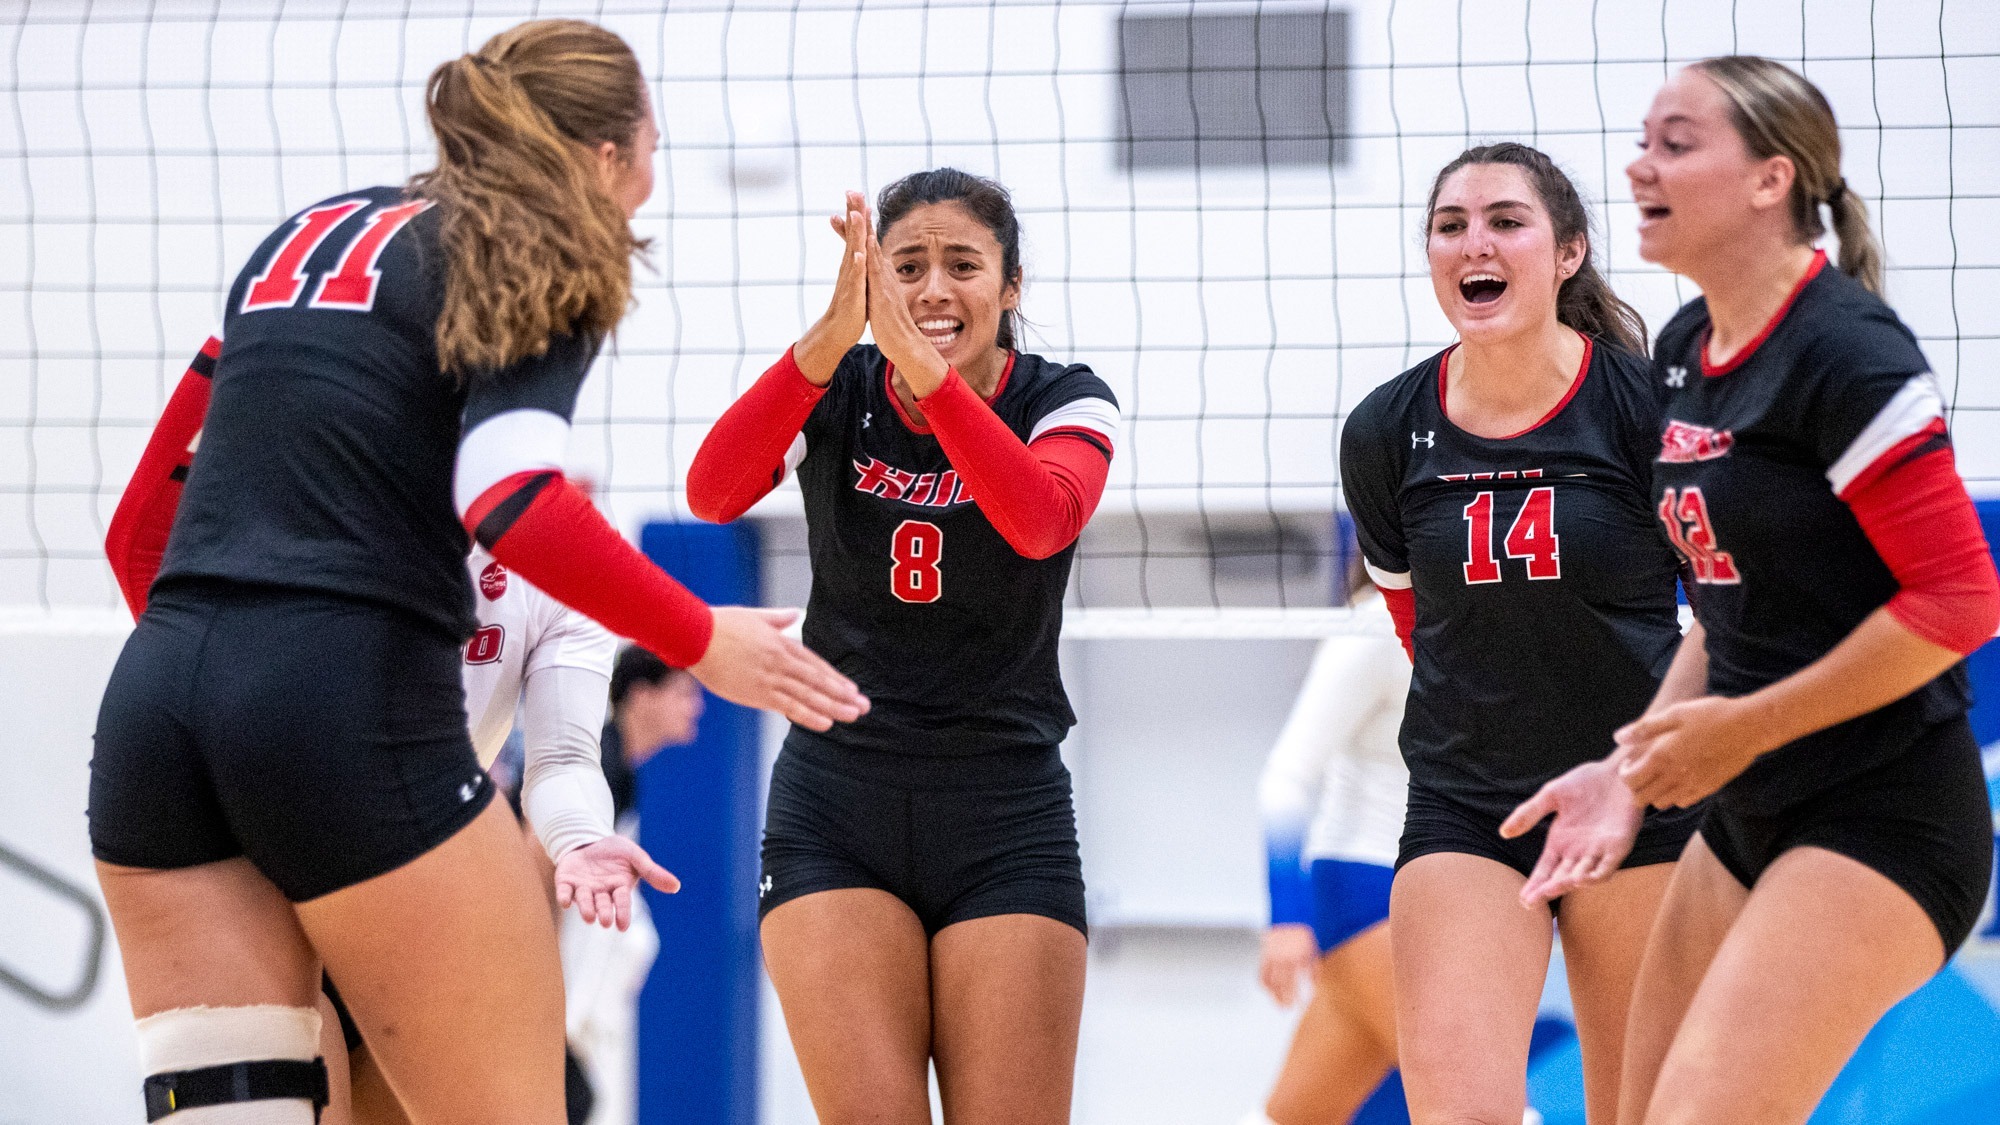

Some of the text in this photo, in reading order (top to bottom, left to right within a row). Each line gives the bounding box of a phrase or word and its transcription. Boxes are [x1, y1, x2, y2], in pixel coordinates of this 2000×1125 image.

[240, 199, 438, 315] 11
[891, 520, 943, 603] 8
[1463, 487, 1561, 585] 14
[1659, 487, 1741, 584] 12
